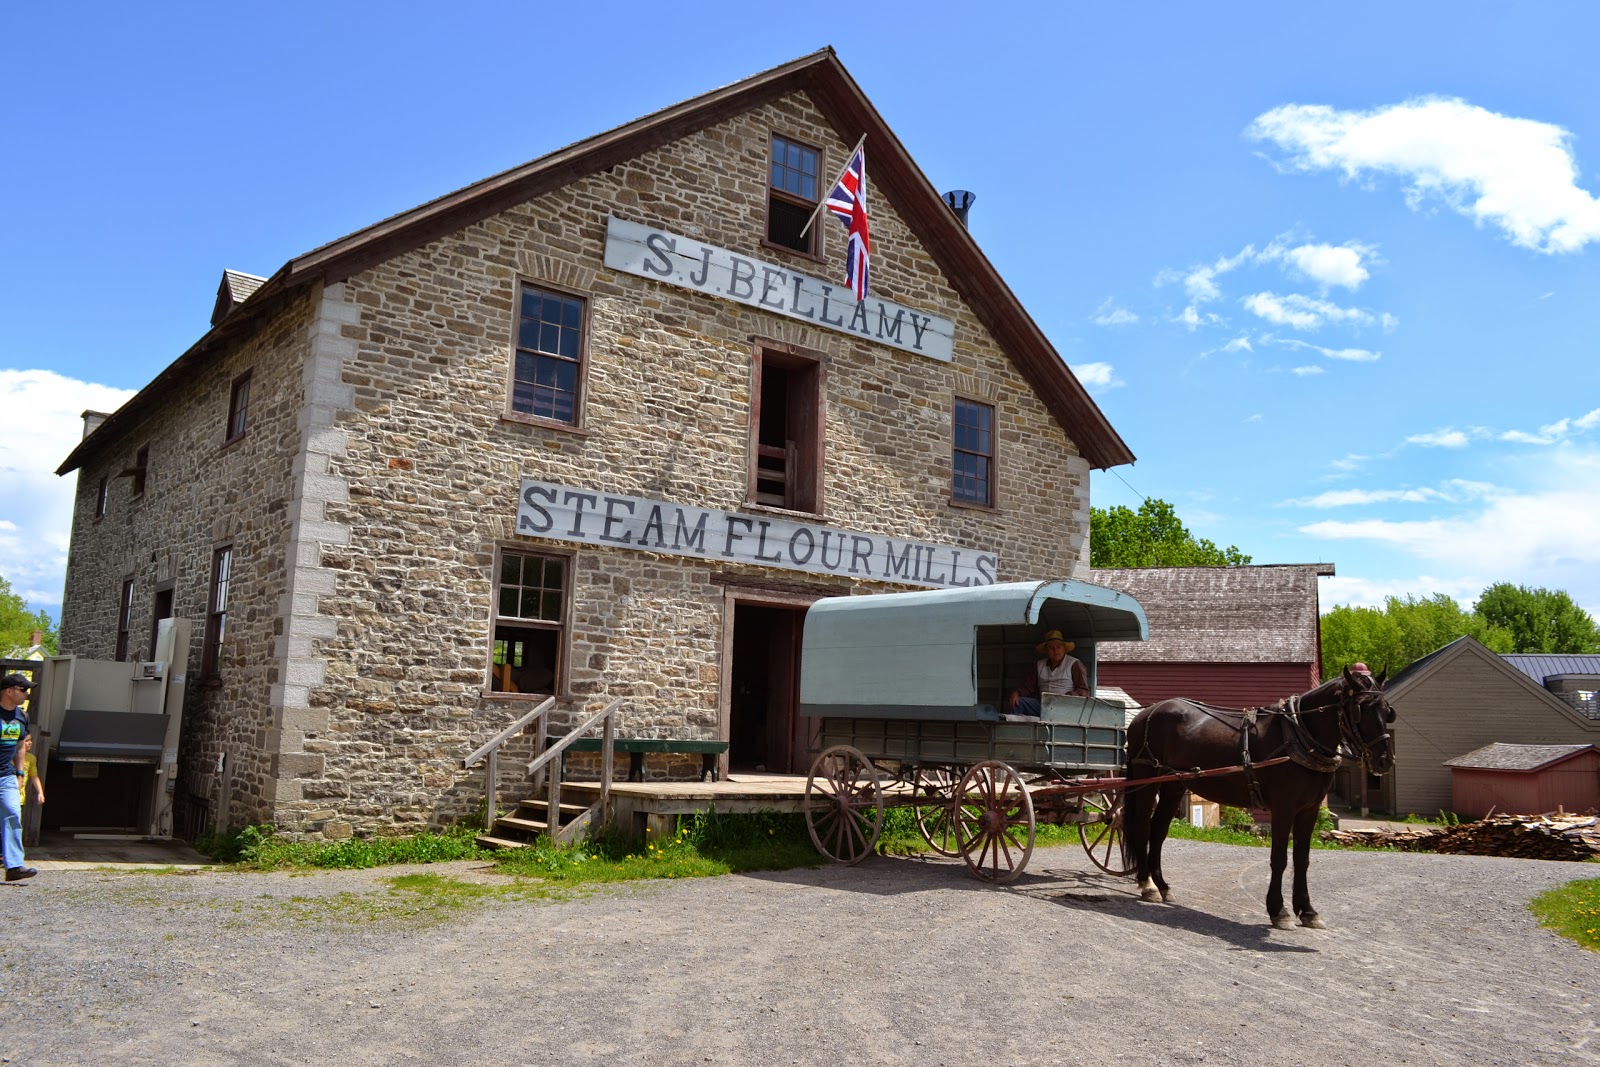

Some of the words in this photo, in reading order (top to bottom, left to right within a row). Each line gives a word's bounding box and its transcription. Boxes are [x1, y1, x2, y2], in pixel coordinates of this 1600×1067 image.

[519, 486, 710, 554] STEAM
[721, 516, 873, 576] FLOUR
[882, 540, 997, 587] MILLS
